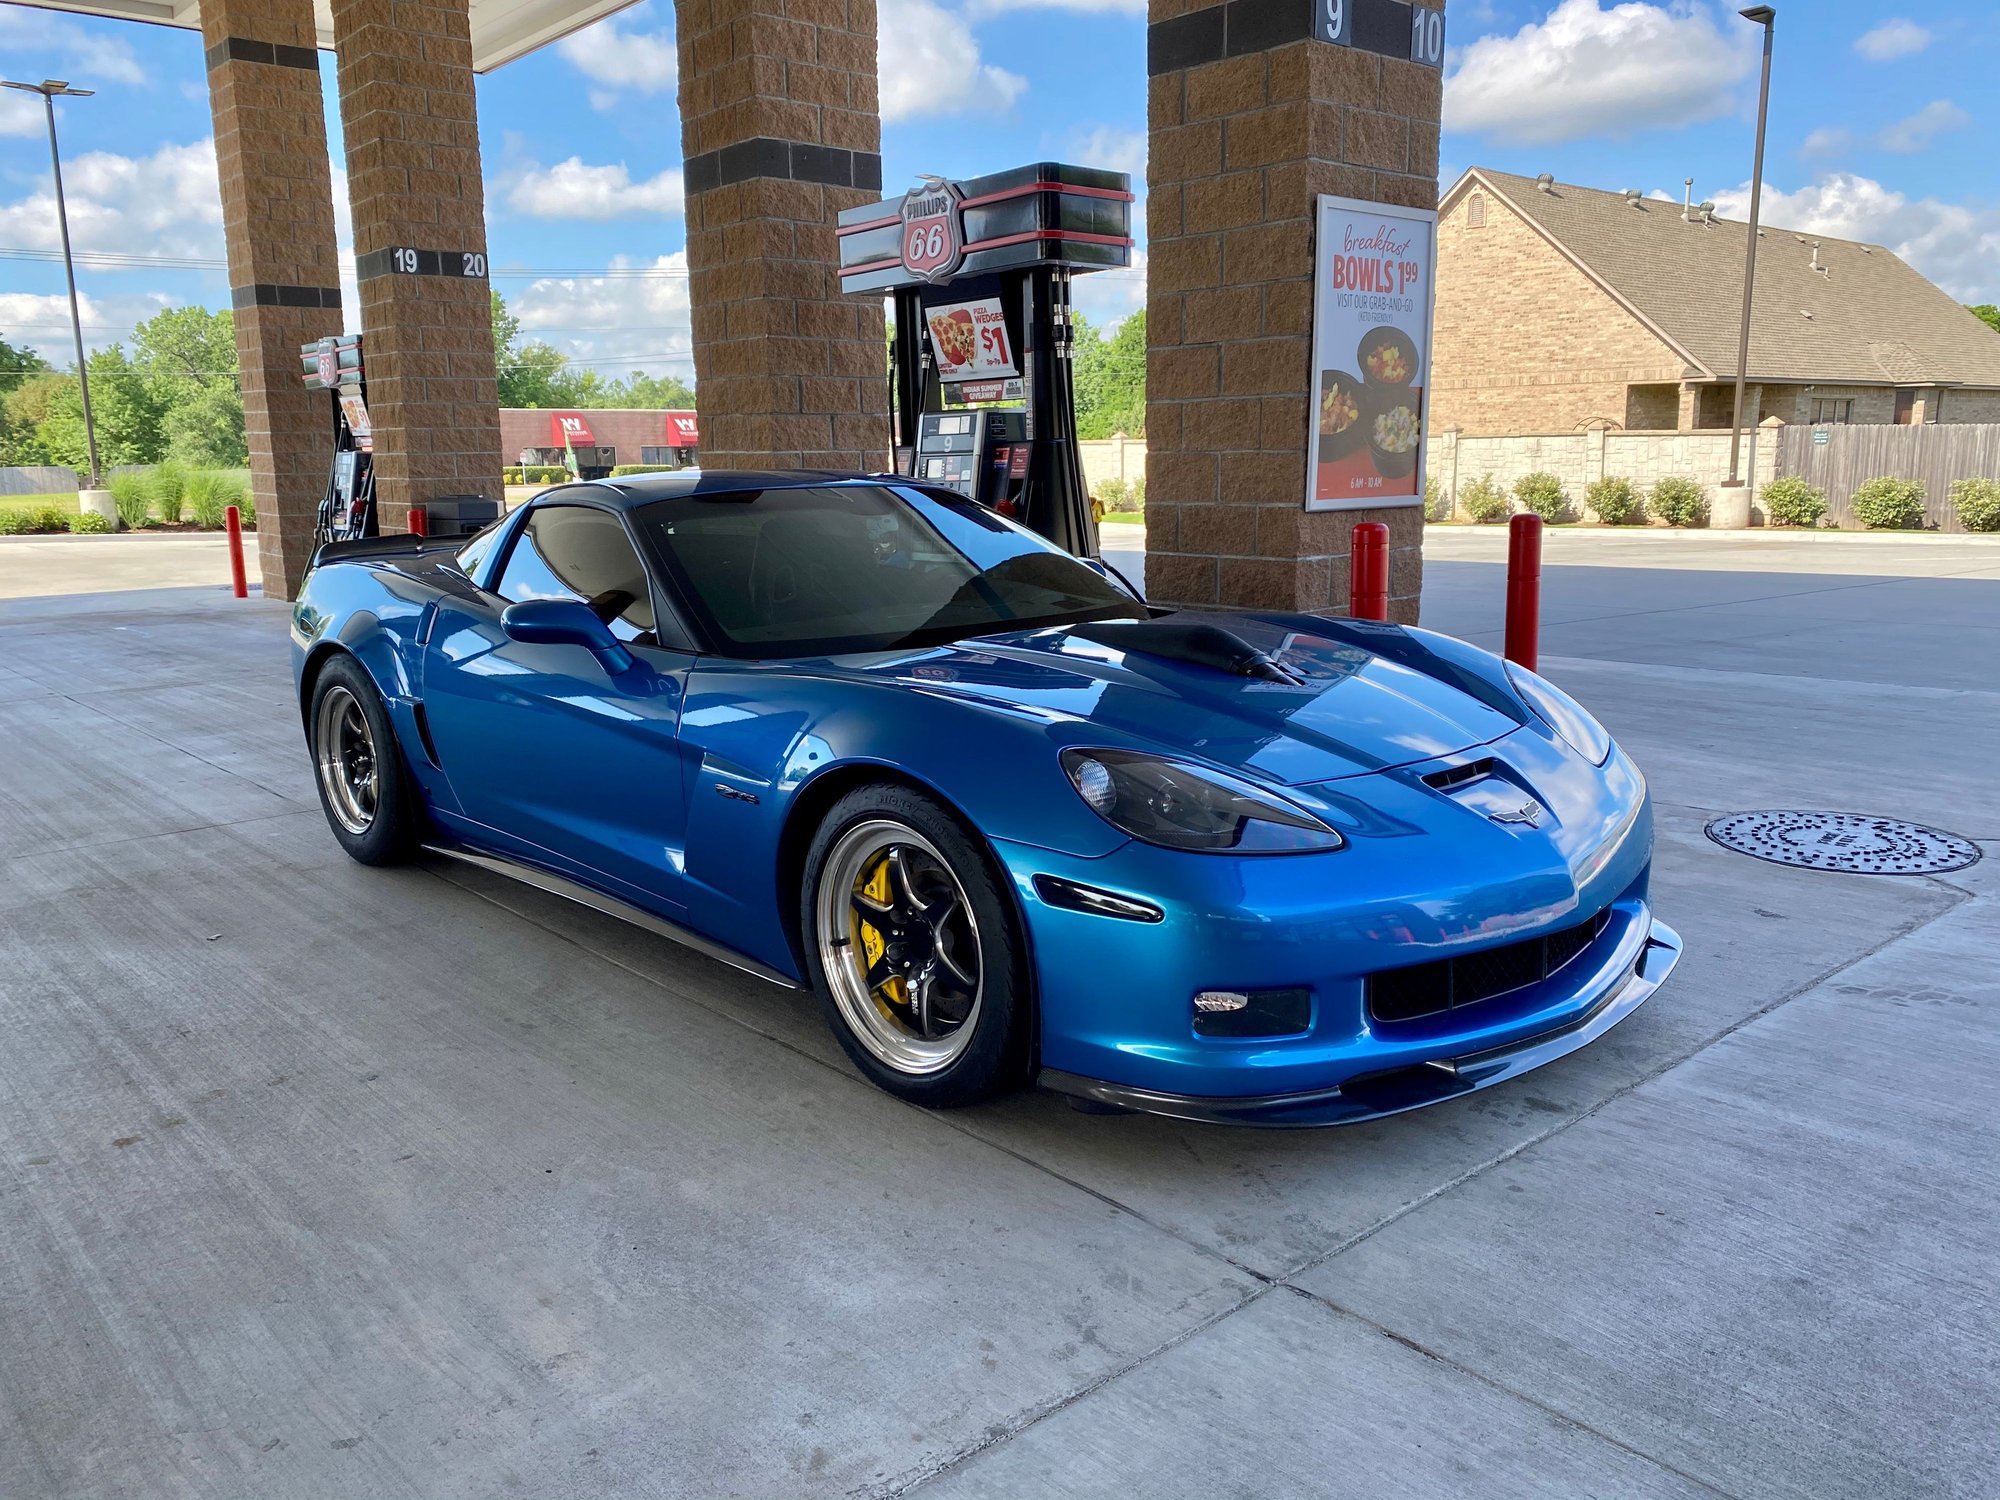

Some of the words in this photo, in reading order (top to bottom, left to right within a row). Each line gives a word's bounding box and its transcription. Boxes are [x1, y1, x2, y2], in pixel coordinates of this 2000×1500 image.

[1326, 0, 1343, 40] 9
[1414, 8, 1442, 63] 10
[907, 196, 949, 220] PHILLIPS
[909, 223, 944, 261] 66
[1344, 223, 1411, 258] breakfast
[394, 248, 418, 273] 19
[463, 252, 486, 278] 20
[1333, 254, 1394, 294] BOWLS
[973, 307, 987, 315] PIZZA
[1336, 293, 1353, 308] VISIT
[1354, 294, 1368, 309] OUR
[1368, 295, 1414, 313] GRAB-AND-GO
[974, 312, 1004, 324] WEDGES
[981, 326, 1008, 365] $1
[319, 359, 330, 377] 66
[969, 391, 997, 400] GIVEAWAY
[943, 435, 953, 453] 9
[1350, 477, 1354, 489] 6
[1355, 477, 1364, 489] AM
[1368, 476, 1374, 488] 10
[1374, 476, 1383, 488] AM
[879, 795, 919, 815] MICKEY
